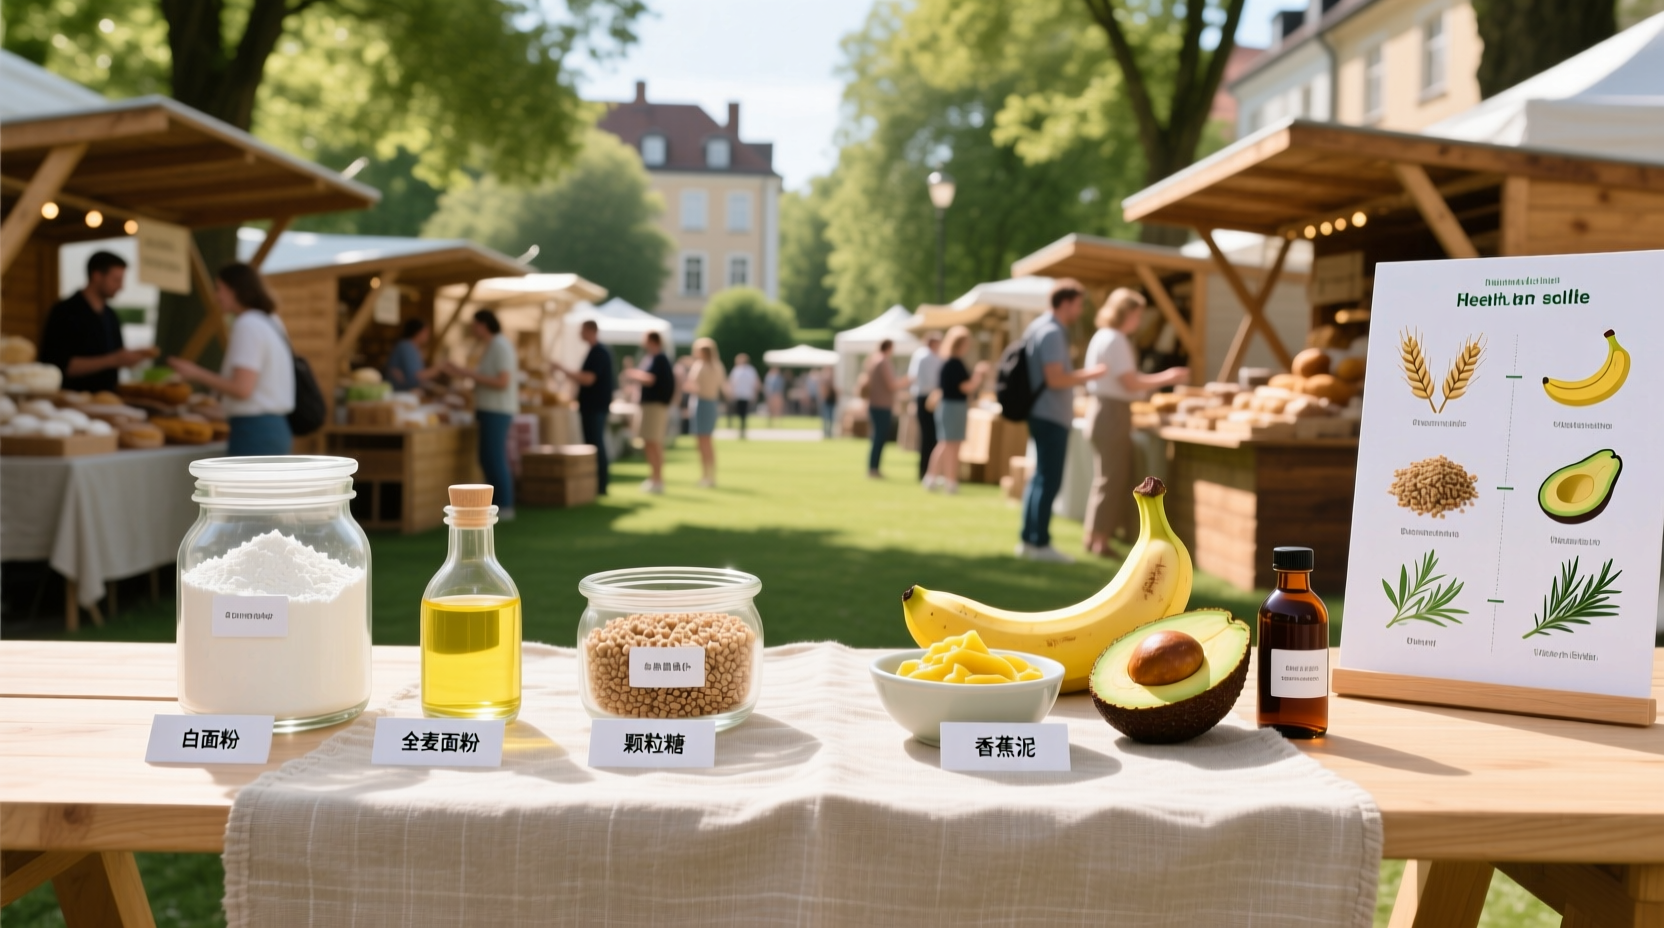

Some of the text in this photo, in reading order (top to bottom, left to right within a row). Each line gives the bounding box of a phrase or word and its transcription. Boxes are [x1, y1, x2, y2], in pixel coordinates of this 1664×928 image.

[182, 728, 240, 750] 白面粉
[401, 730, 480, 753] 全麦面粉
[623, 732, 686, 755] 颗粒糖
[975, 735, 1036, 758] 香蕉泥
